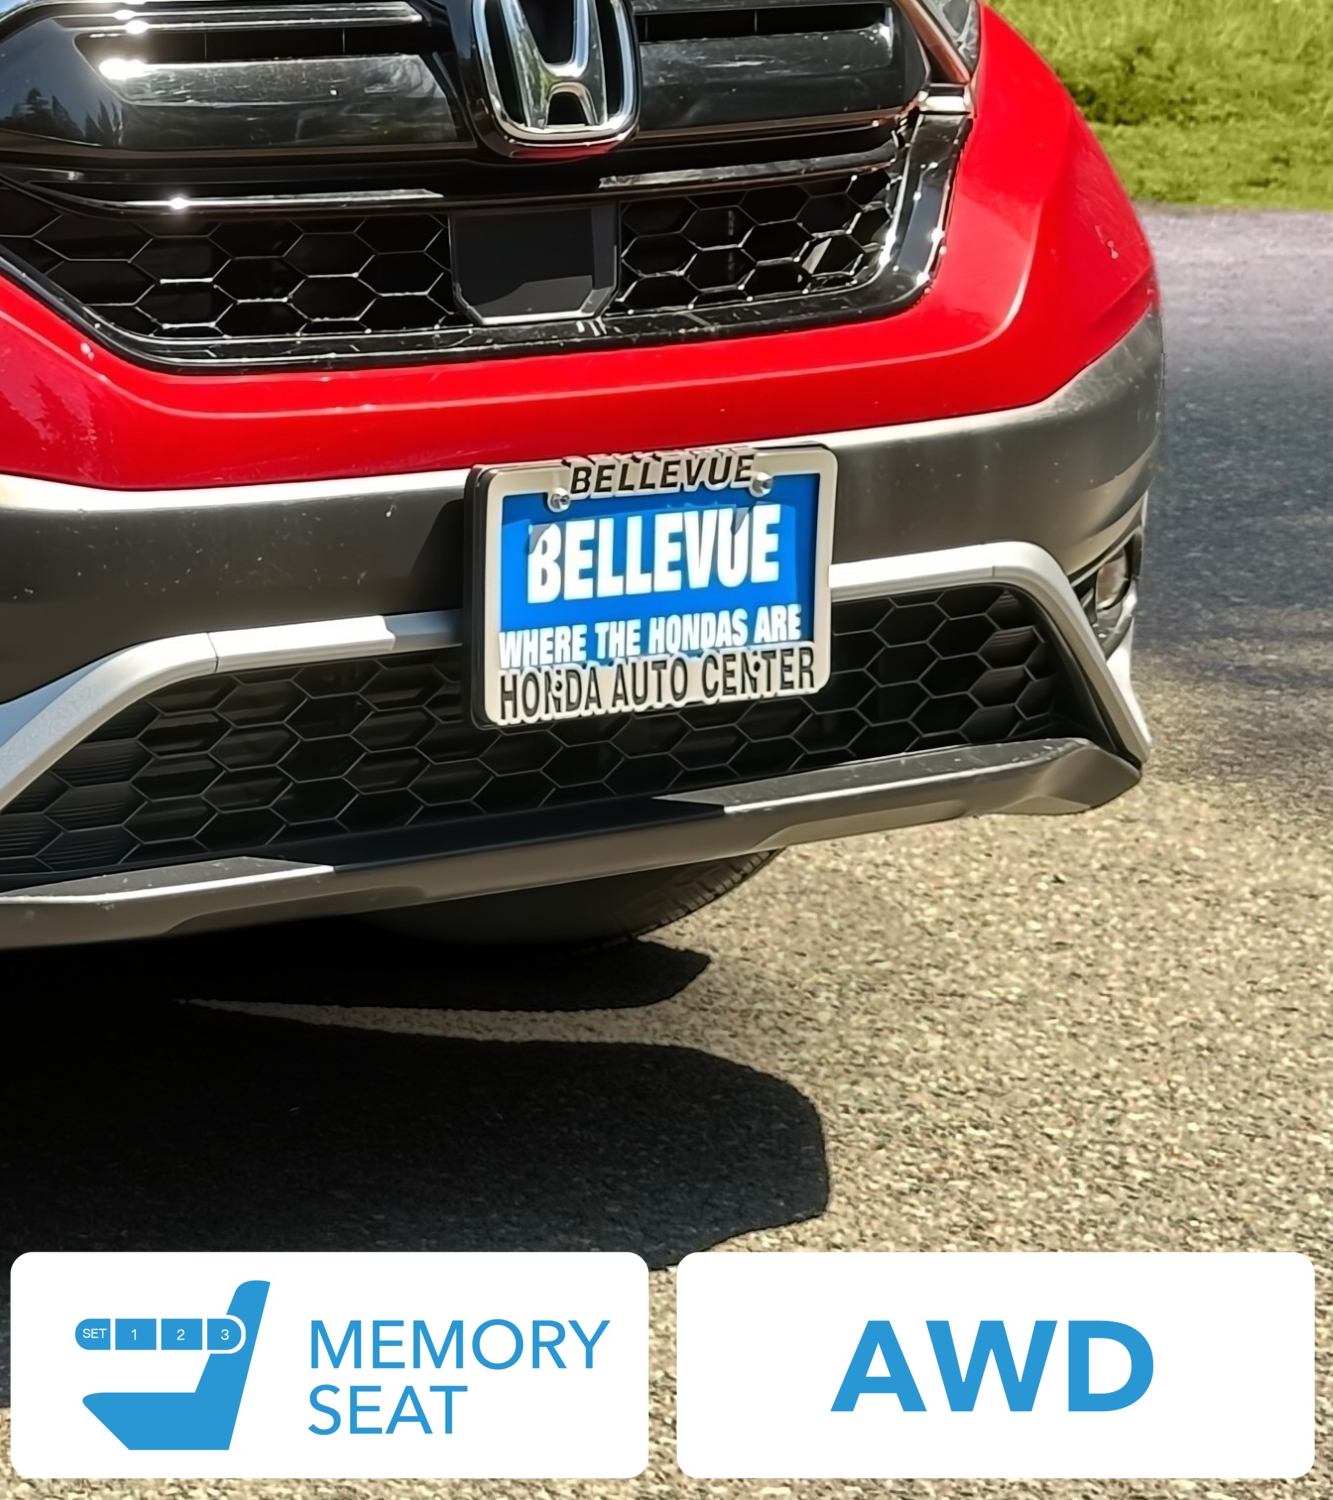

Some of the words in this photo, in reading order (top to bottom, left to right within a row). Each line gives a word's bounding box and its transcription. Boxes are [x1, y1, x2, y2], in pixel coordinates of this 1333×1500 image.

[570, 454, 755, 494] BELLEVUE
[527, 504, 781, 604] BELLEVUE
[499, 625, 587, 669] WHERE
[595, 619, 641, 659] THE
[648, 608, 748, 654] HONDAS
[753, 604, 801, 644] ARE
[500, 665, 602, 721] HONDA
[611, 656, 689, 708] AUTO
[700, 646, 815, 699] CENTER
